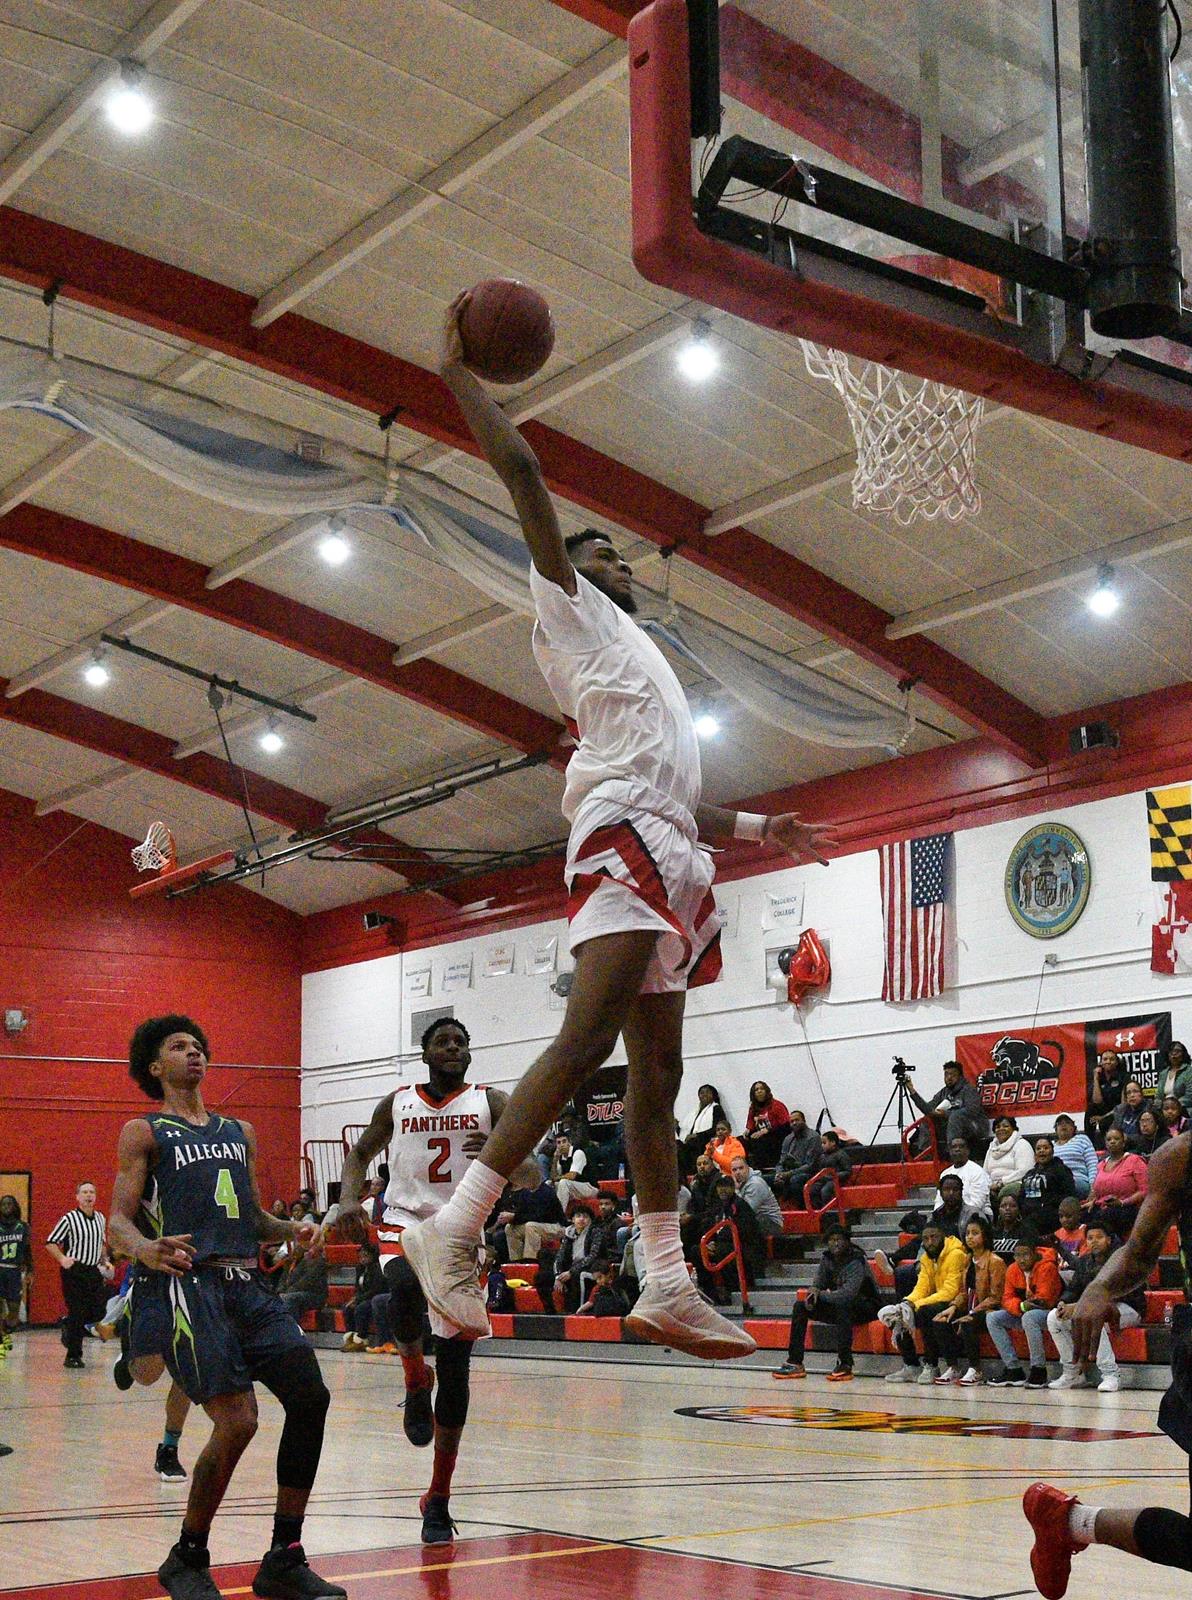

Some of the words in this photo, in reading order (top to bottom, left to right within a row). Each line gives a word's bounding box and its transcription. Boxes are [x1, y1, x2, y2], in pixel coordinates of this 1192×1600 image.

[980, 1077, 1059, 1106] BCCC
[401, 1113, 480, 1135] PANTHERS
[587, 1101, 624, 1121] DTLR
[174, 1142, 247, 1171] ALLEGANY
[427, 1137, 452, 1184] 2
[214, 1168, 240, 1219] 4
